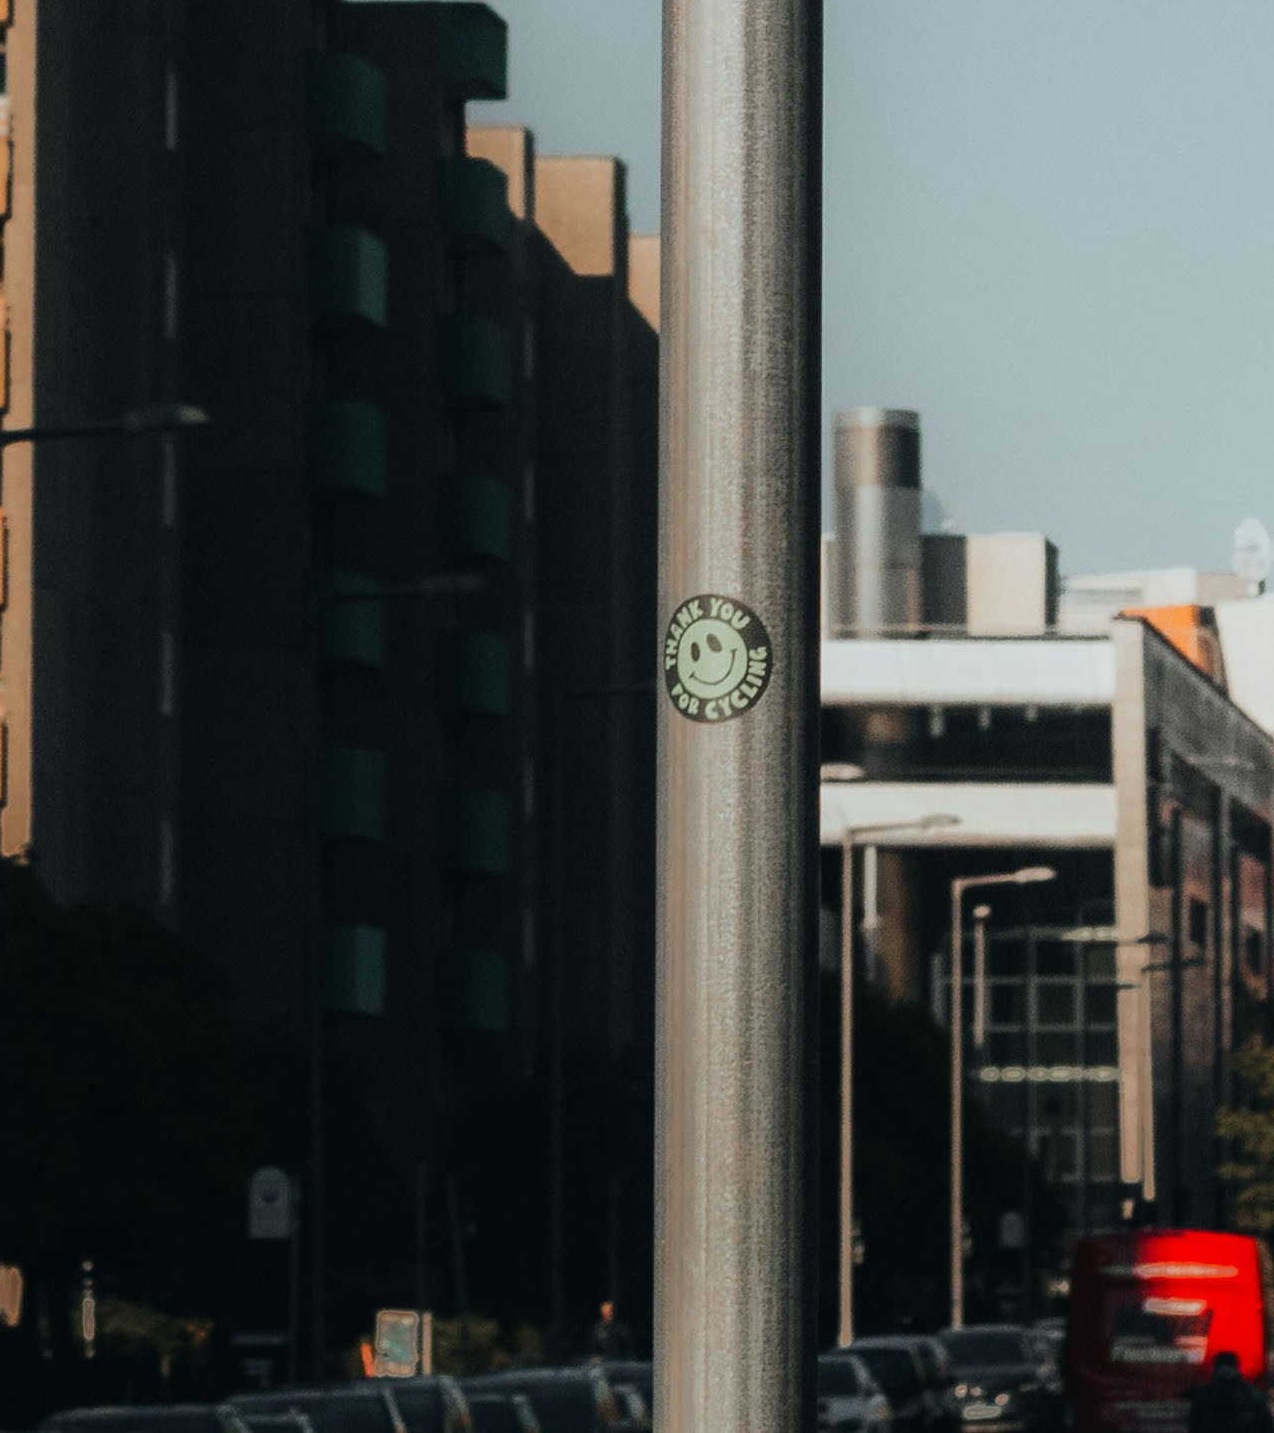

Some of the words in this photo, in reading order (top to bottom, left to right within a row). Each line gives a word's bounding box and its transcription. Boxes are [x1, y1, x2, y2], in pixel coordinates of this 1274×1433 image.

[666, 599, 703, 670] THANK
[709, 598, 750, 630] YOU
[671, 683, 700, 715] FOR
[705, 646, 767, 719] CYCLING
